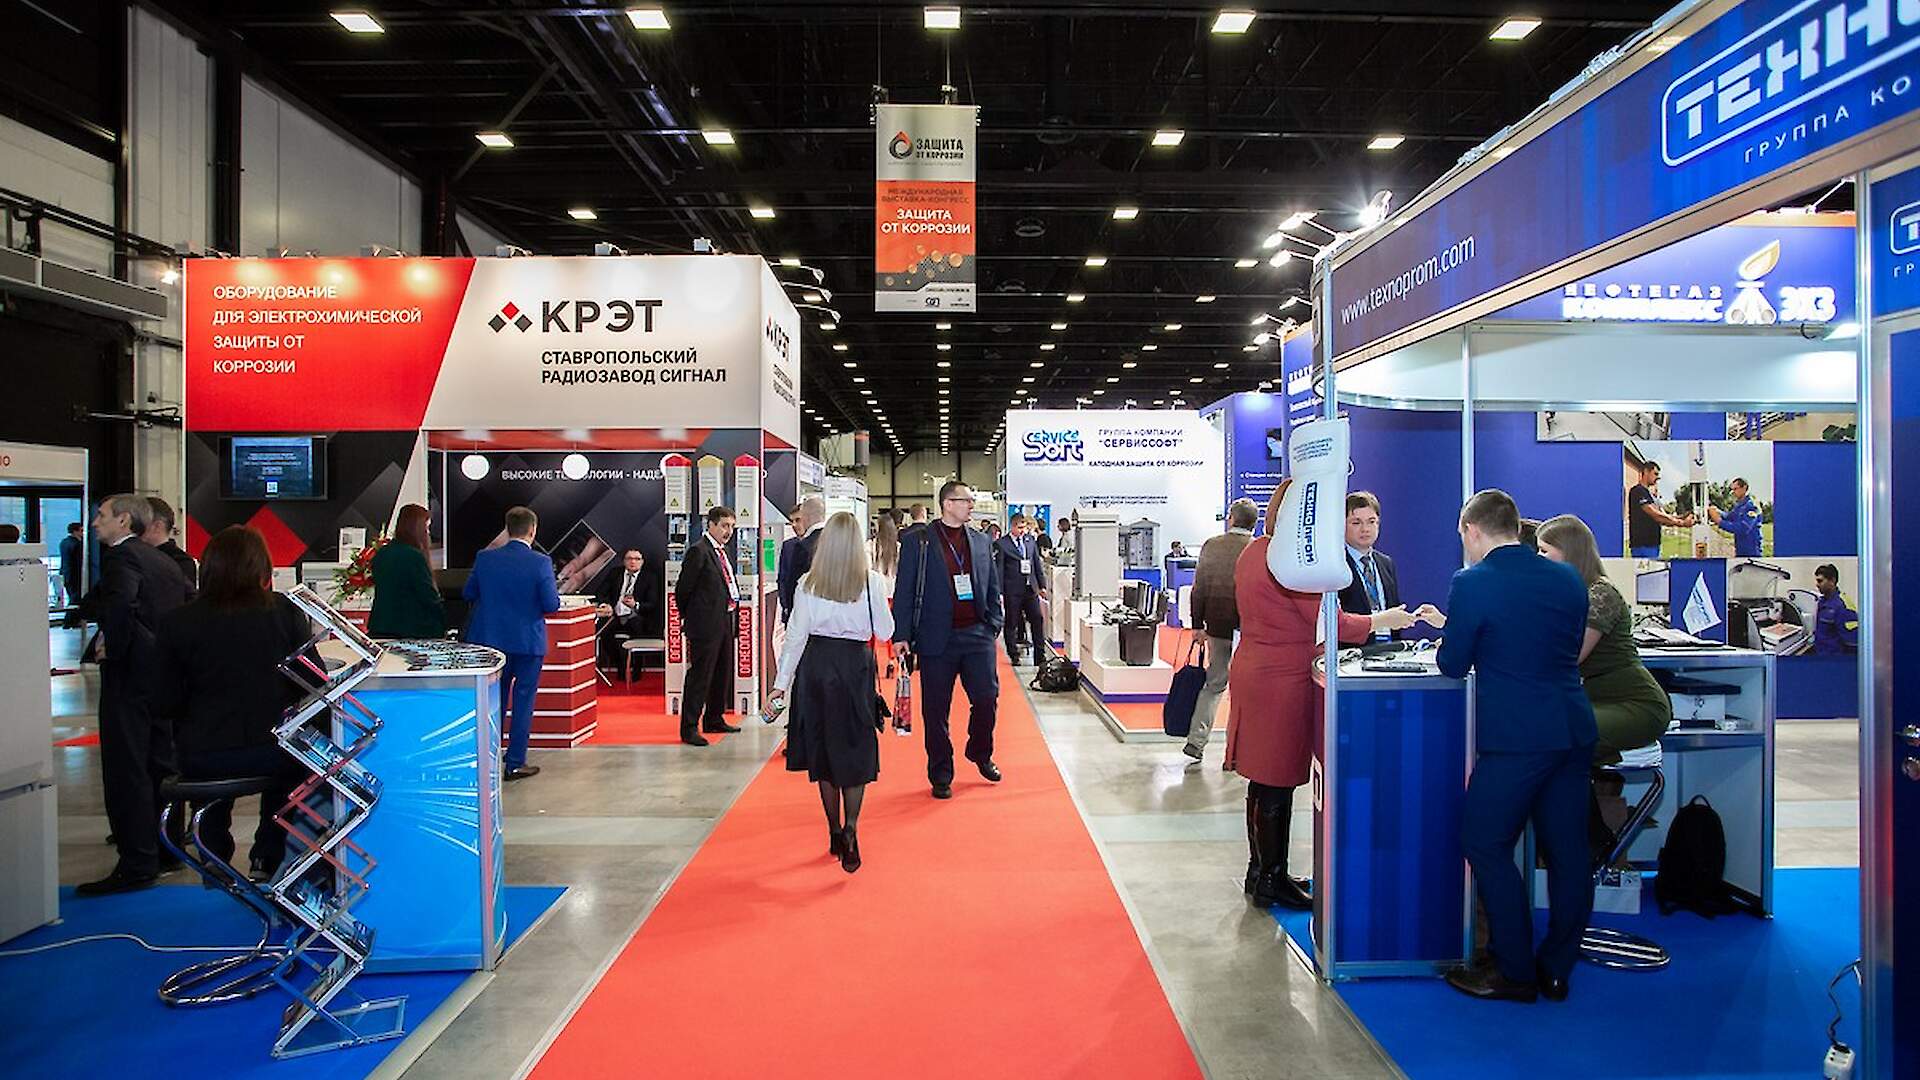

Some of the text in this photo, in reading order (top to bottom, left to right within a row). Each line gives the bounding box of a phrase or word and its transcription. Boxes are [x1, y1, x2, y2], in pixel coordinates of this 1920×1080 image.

[1744, 76, 1912, 163] ГРУППА КО
[916, 139, 964, 151] ЗАЩИТА
[896, 208, 953, 220] ЗАЩИТА
[880, 222, 971, 234] ОТ КОРРОЗИИ
[1341, 235, 1476, 325] www.texnoprom.com
[213, 285, 337, 300] ОБОРУДОВАНИЕ
[212, 307, 422, 325] ДЛЯ ЭЛЕКТРОХИМИЧЕСКОЙ
[542, 300, 663, 333] КРЭТ
[213, 335, 305, 351] ЗАЩИТЫ ОТ
[541, 348, 698, 365] СТАВРОПОЛЬСКИЙ
[213, 360, 296, 373] КОРРОЗИИ
[541, 368, 727, 385] РАДИОЗАВОД СИГНАЛ
[502, 469, 553, 481] ВЫСОКИЕ
[738, 609, 752, 674] ОГНЕОПАСНО
